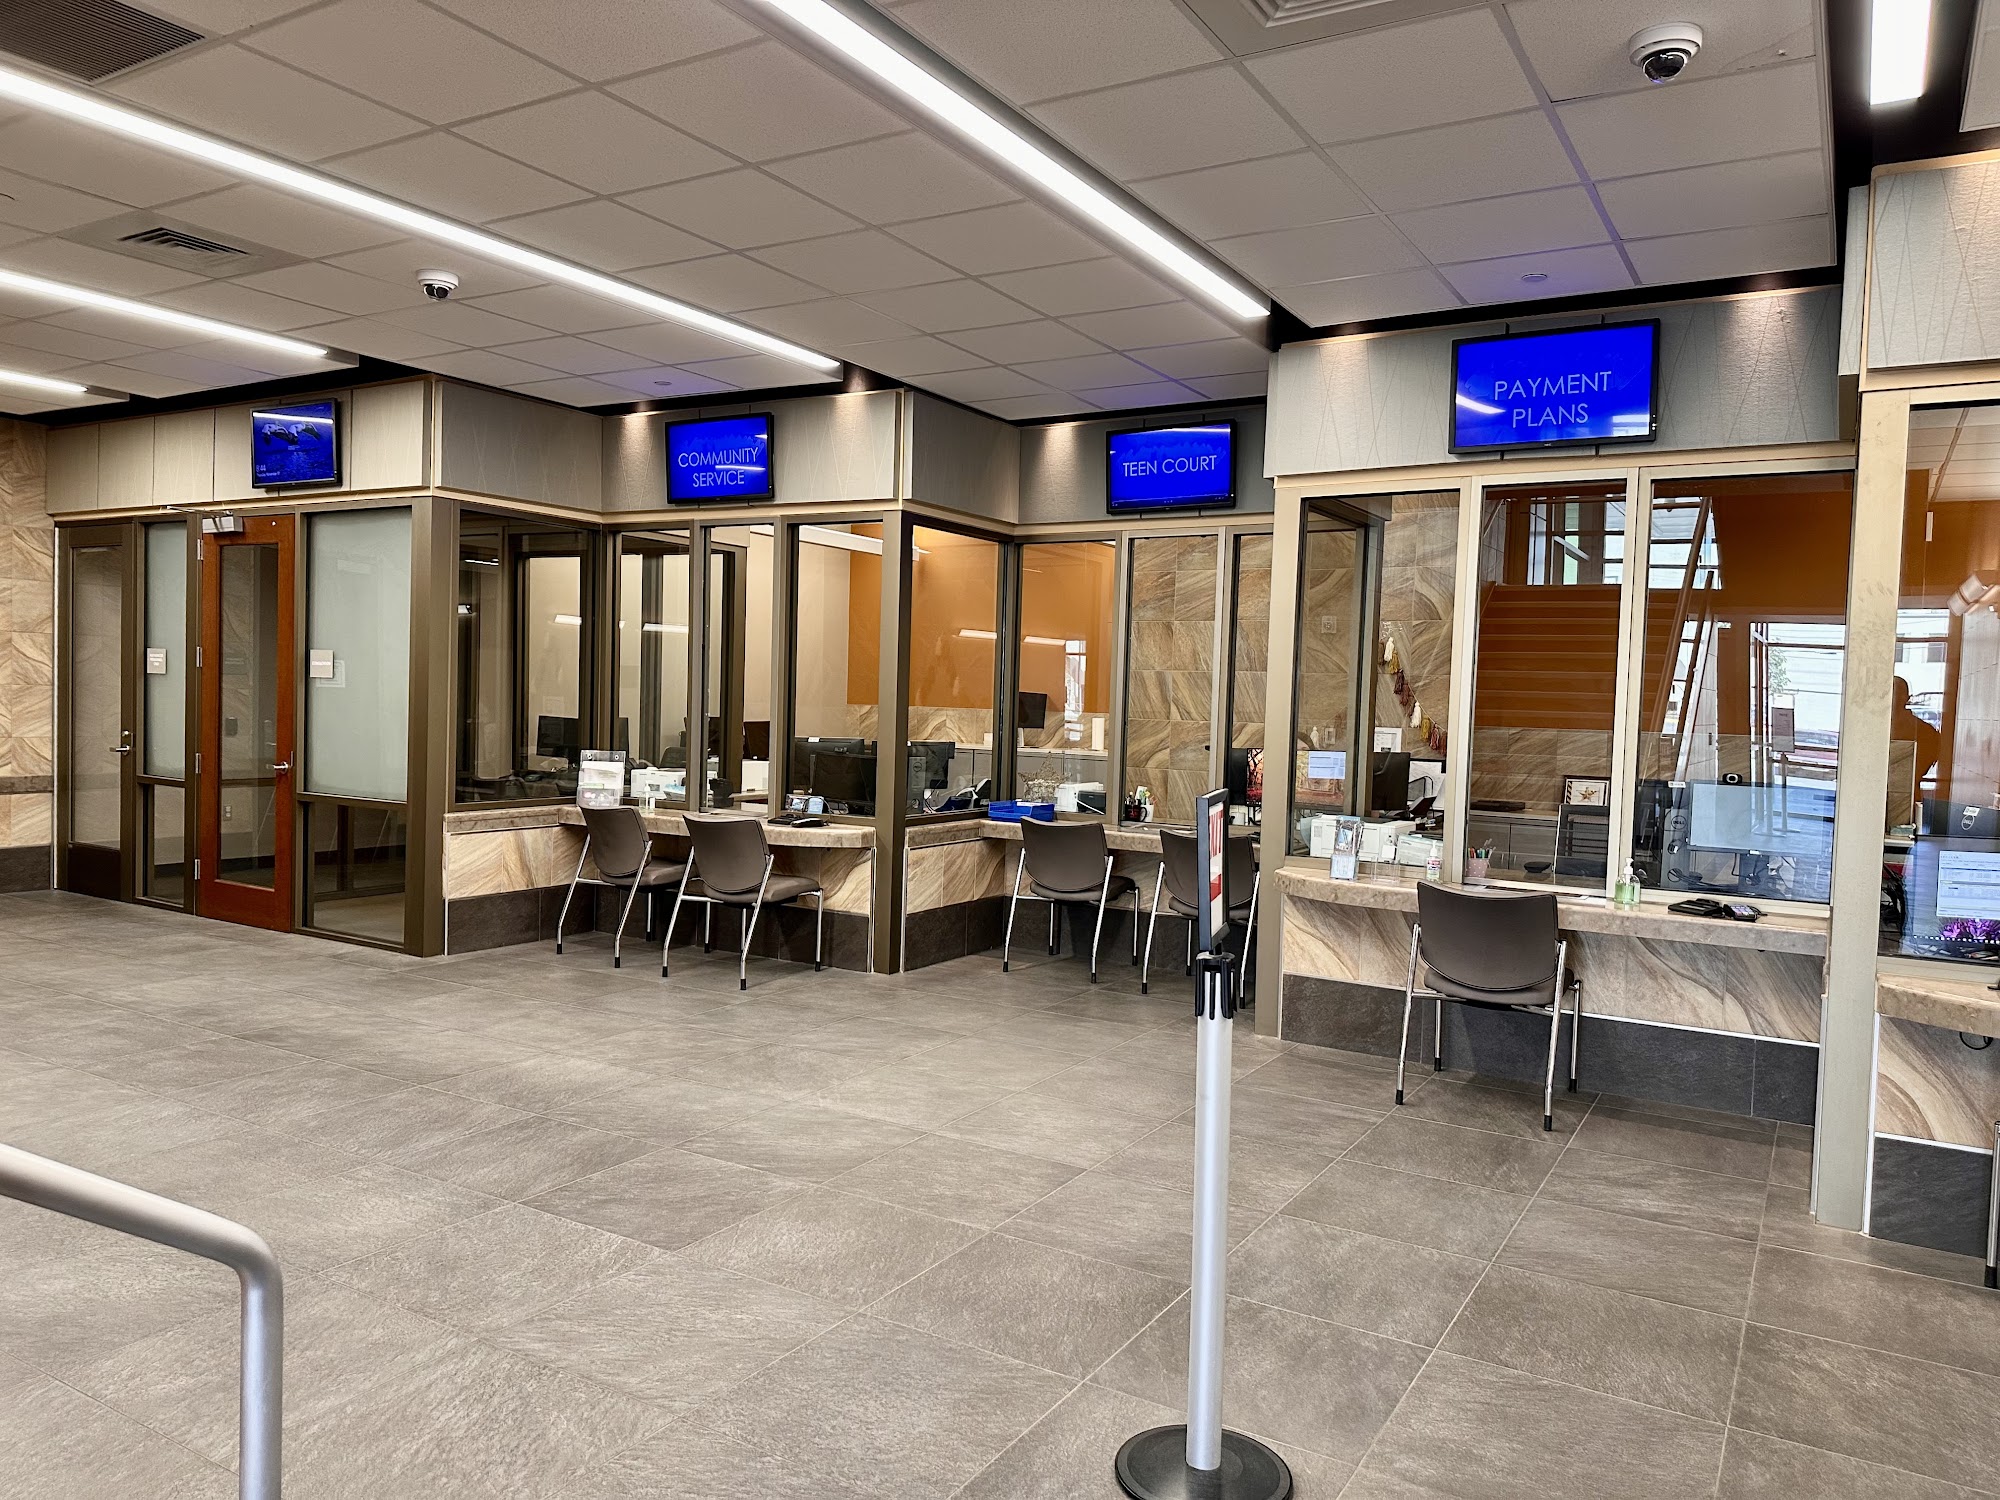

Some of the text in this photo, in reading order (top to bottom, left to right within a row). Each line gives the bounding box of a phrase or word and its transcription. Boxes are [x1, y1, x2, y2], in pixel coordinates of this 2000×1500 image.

[1494, 371, 1612, 400] PAYMENT
[1512, 403, 1589, 428] PLANS
[678, 447, 758, 467] COMMUNITY
[1123, 455, 1217, 477] TEEN COURT
[692, 470, 745, 487] SERVICE
[1209, 810, 1223, 859] XIT
